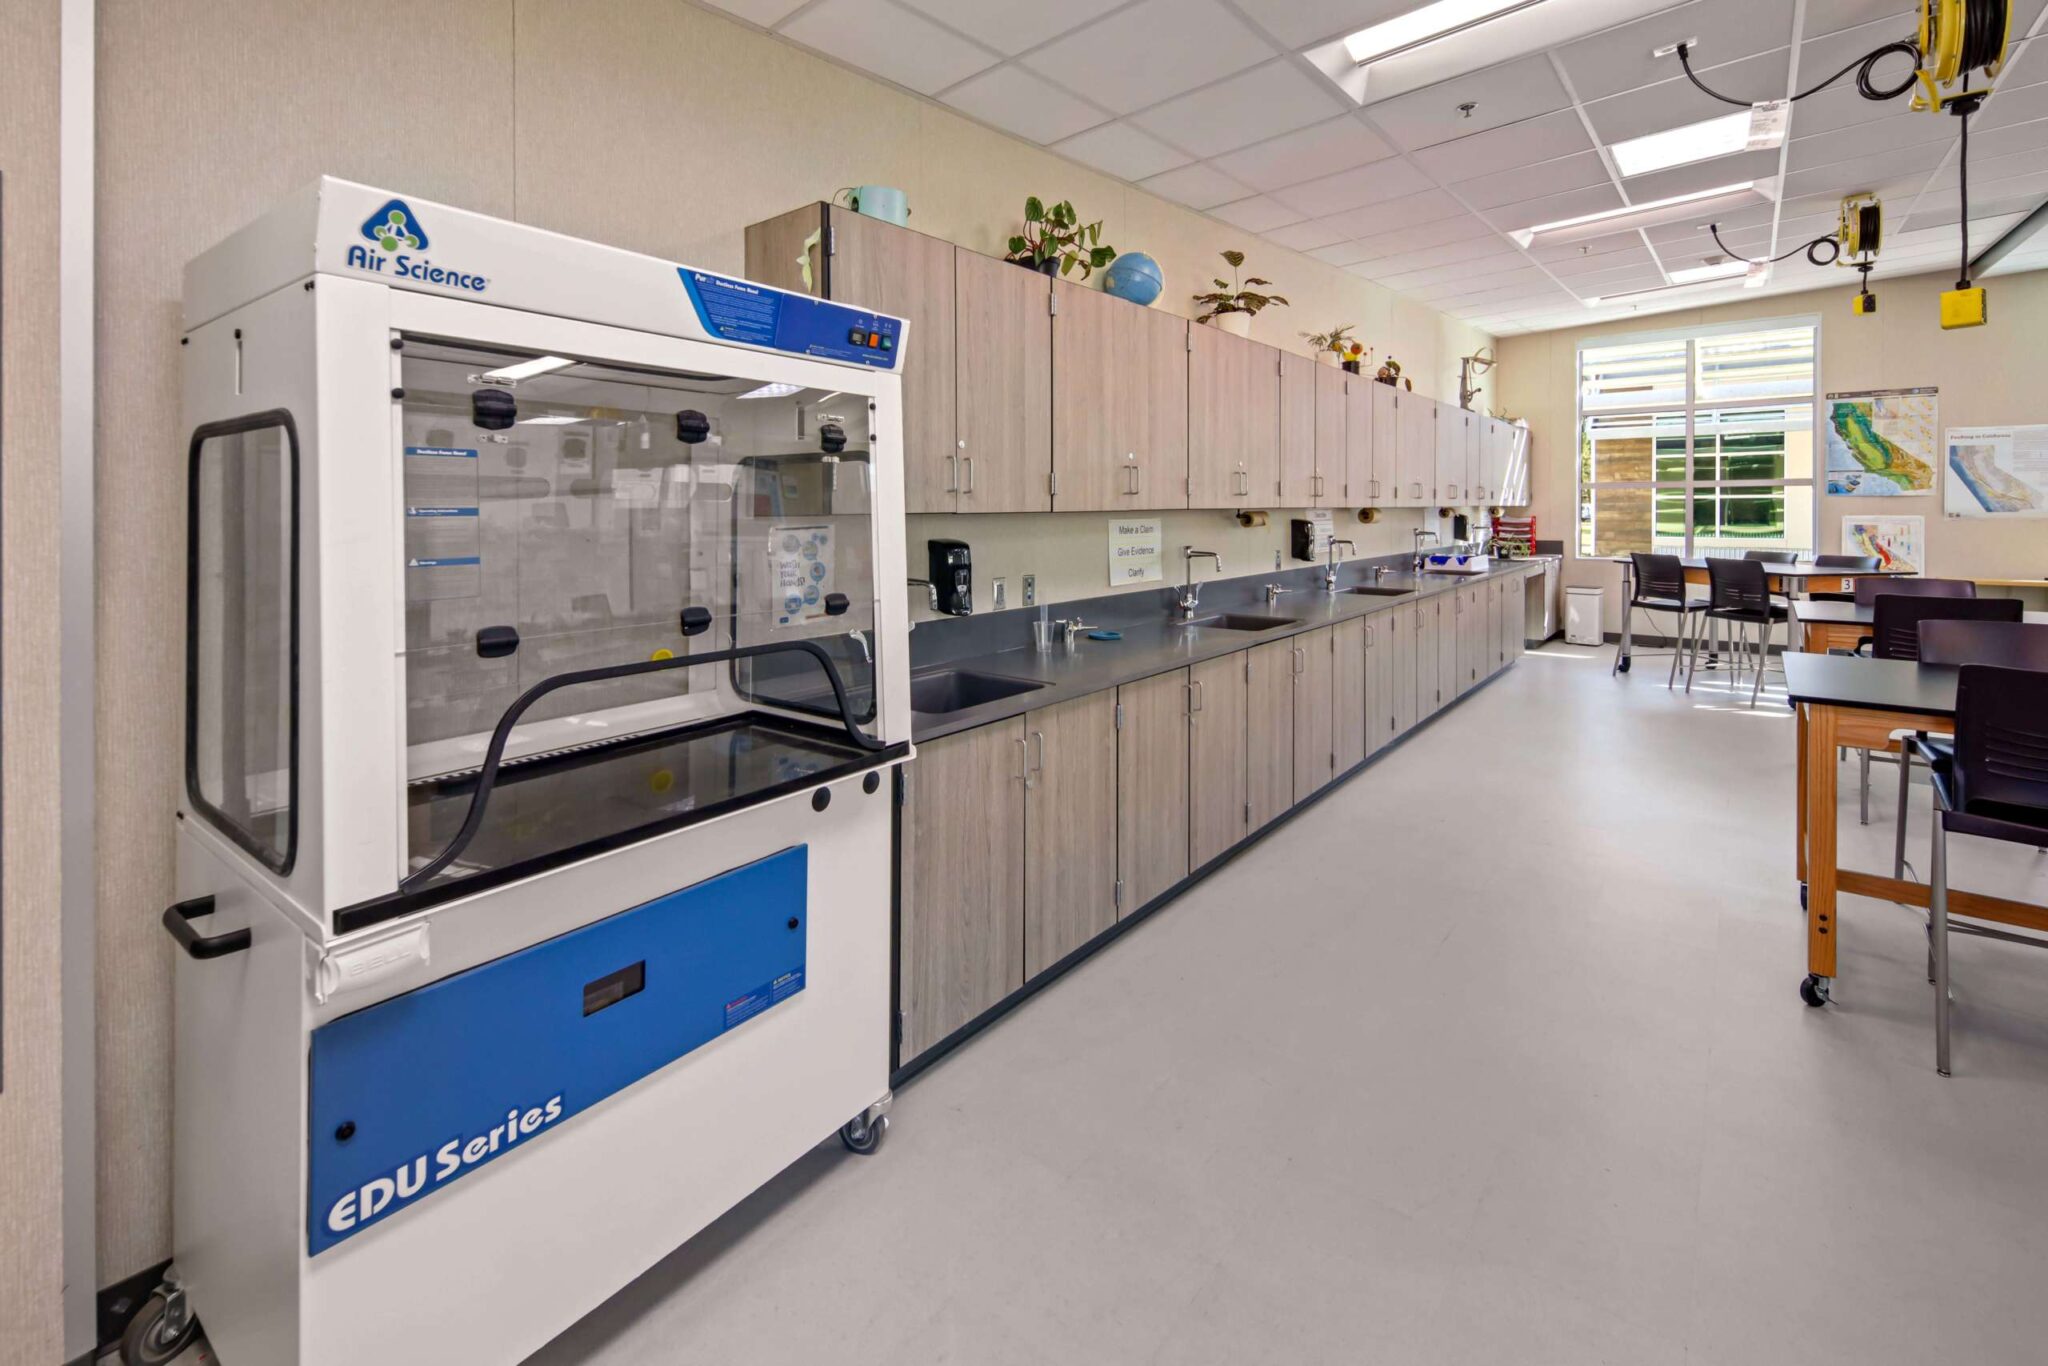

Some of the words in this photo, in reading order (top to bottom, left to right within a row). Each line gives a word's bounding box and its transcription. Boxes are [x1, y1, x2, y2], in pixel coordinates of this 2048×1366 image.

[347, 245, 387, 271] Air
[394, 255, 486, 291] Science
[1118, 526, 1134, 535] Make
[1140, 525, 1154, 534] Claim
[1117, 547, 1130, 557] Give
[1131, 546, 1155, 556] Evidence
[1127, 567, 1145, 578] Clarify
[1844, 579, 1851, 590] 3
[327, 1155, 427, 1232] EDU
[435, 1095, 562, 1182] Series
